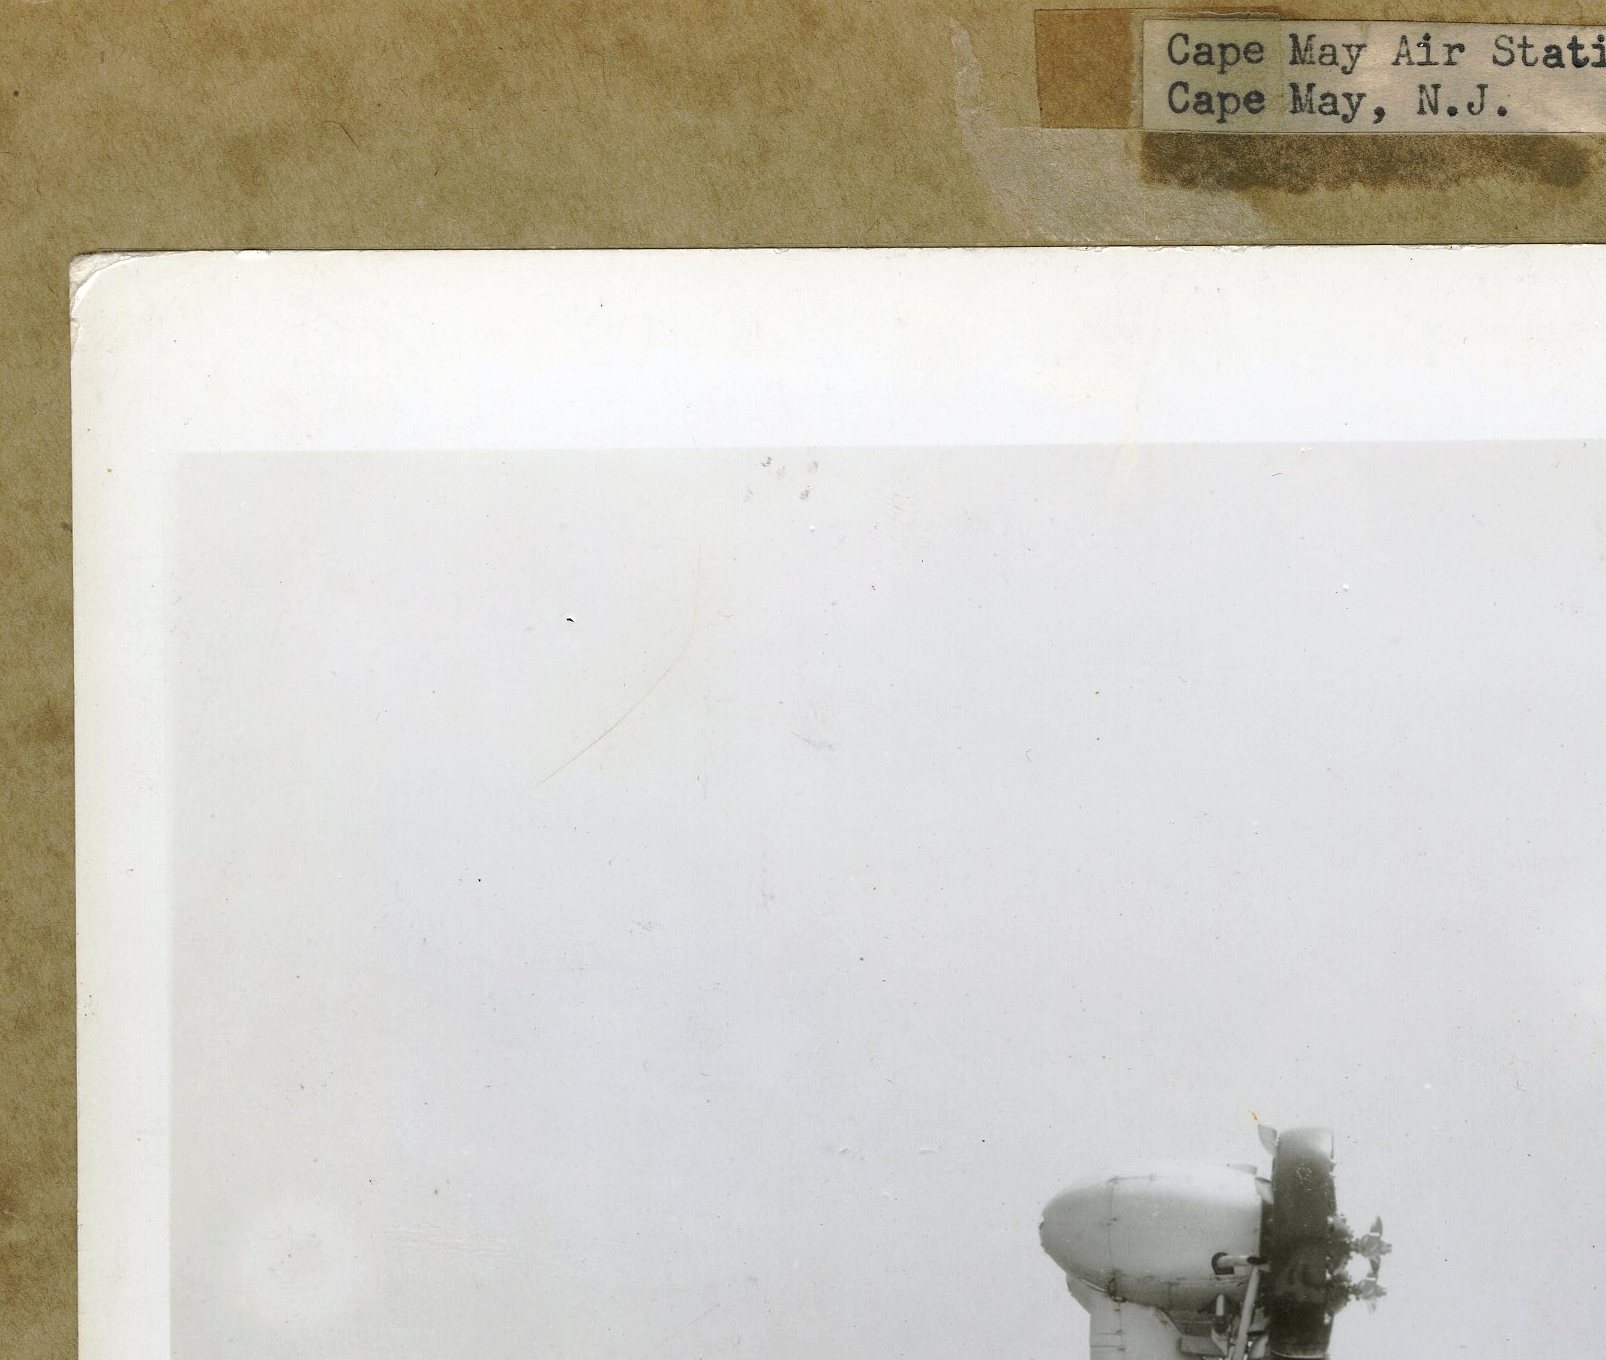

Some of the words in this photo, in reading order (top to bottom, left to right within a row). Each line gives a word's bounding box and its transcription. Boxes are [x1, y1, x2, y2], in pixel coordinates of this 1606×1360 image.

[1168, 33, 1264, 74] Cape
[1289, 33, 1367, 75] May
[1391, 33, 1465, 66] Air
[1168, 81, 1266, 123] Cape
[1289, 83, 1385, 124] May,
[1417, 84, 1507, 116] N.J.
